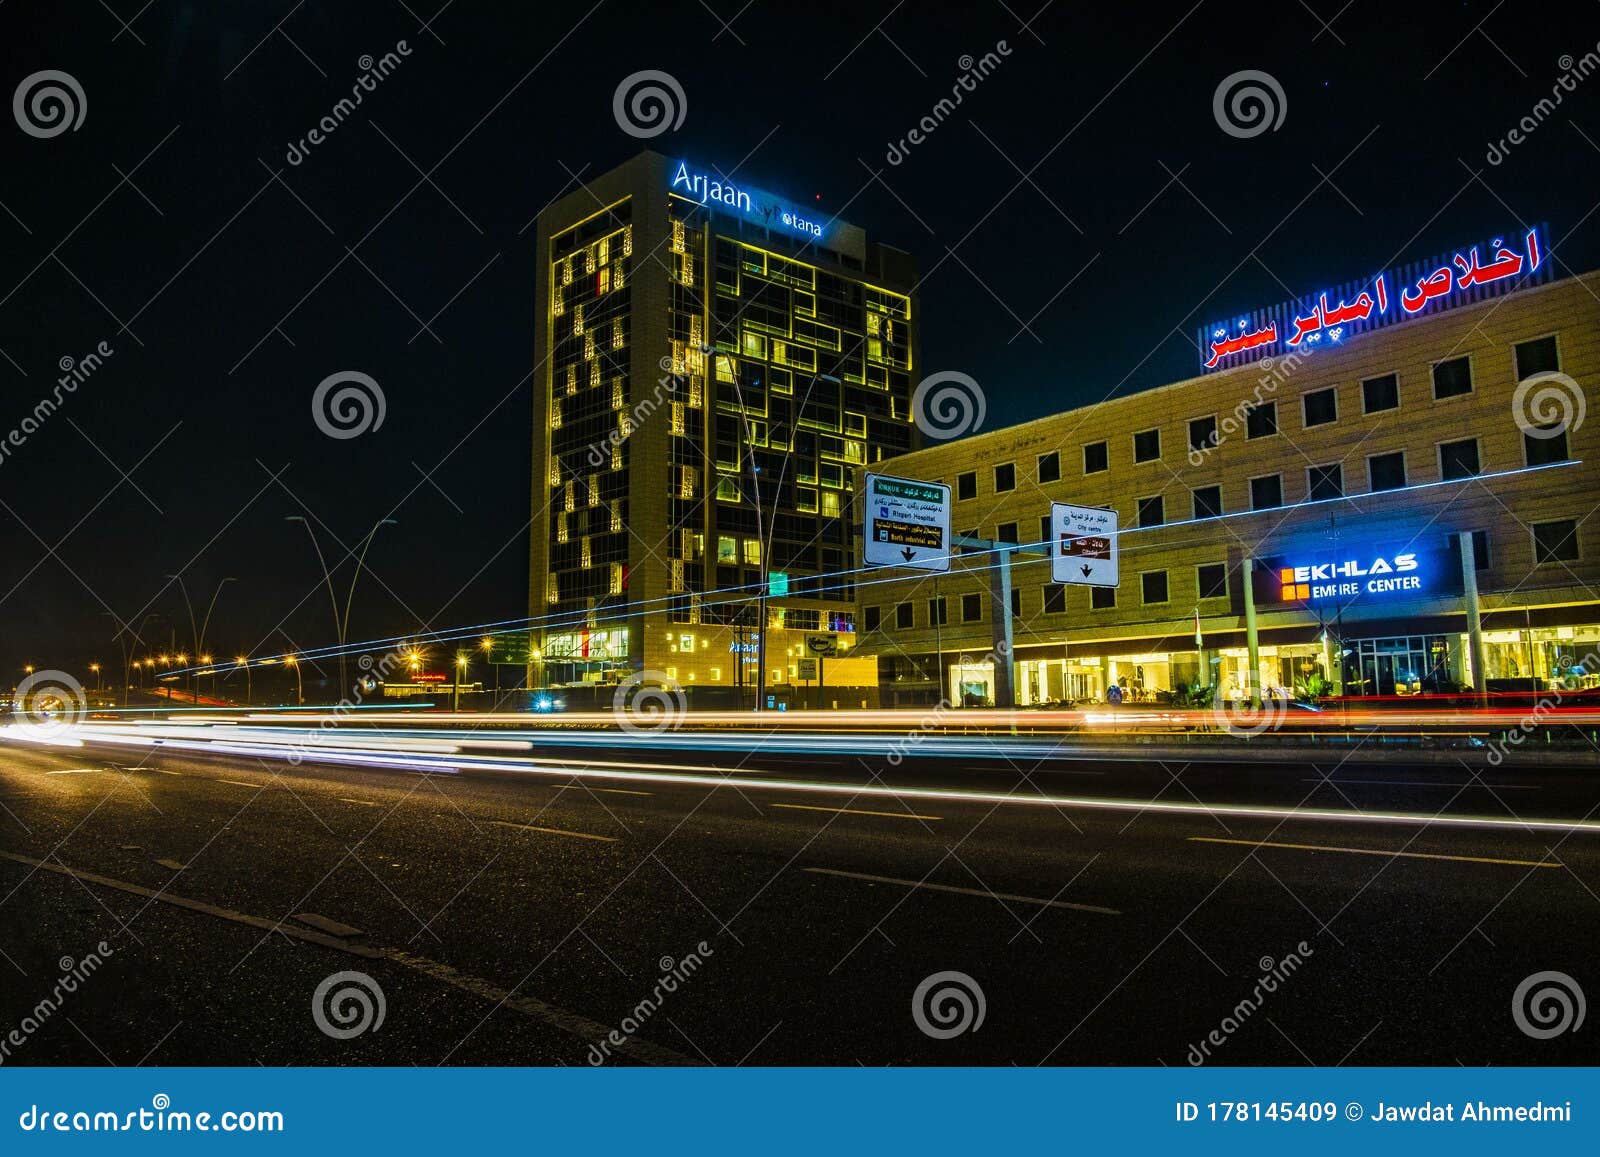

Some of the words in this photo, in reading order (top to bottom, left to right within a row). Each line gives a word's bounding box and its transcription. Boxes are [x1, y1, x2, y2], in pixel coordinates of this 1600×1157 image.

[672, 161, 750, 212] Arjaan
[1402, 228, 1540, 313] اخلاص
[1203, 319, 1277, 369] سنتر
[913, 512, 935, 521] Hospital
[1294, 553, 1419, 582] EKHLAS
[1312, 582, 1359, 599] EMPIRE
[1367, 576, 1421, 593] CENTER
[728, 641, 759, 653] Araan
